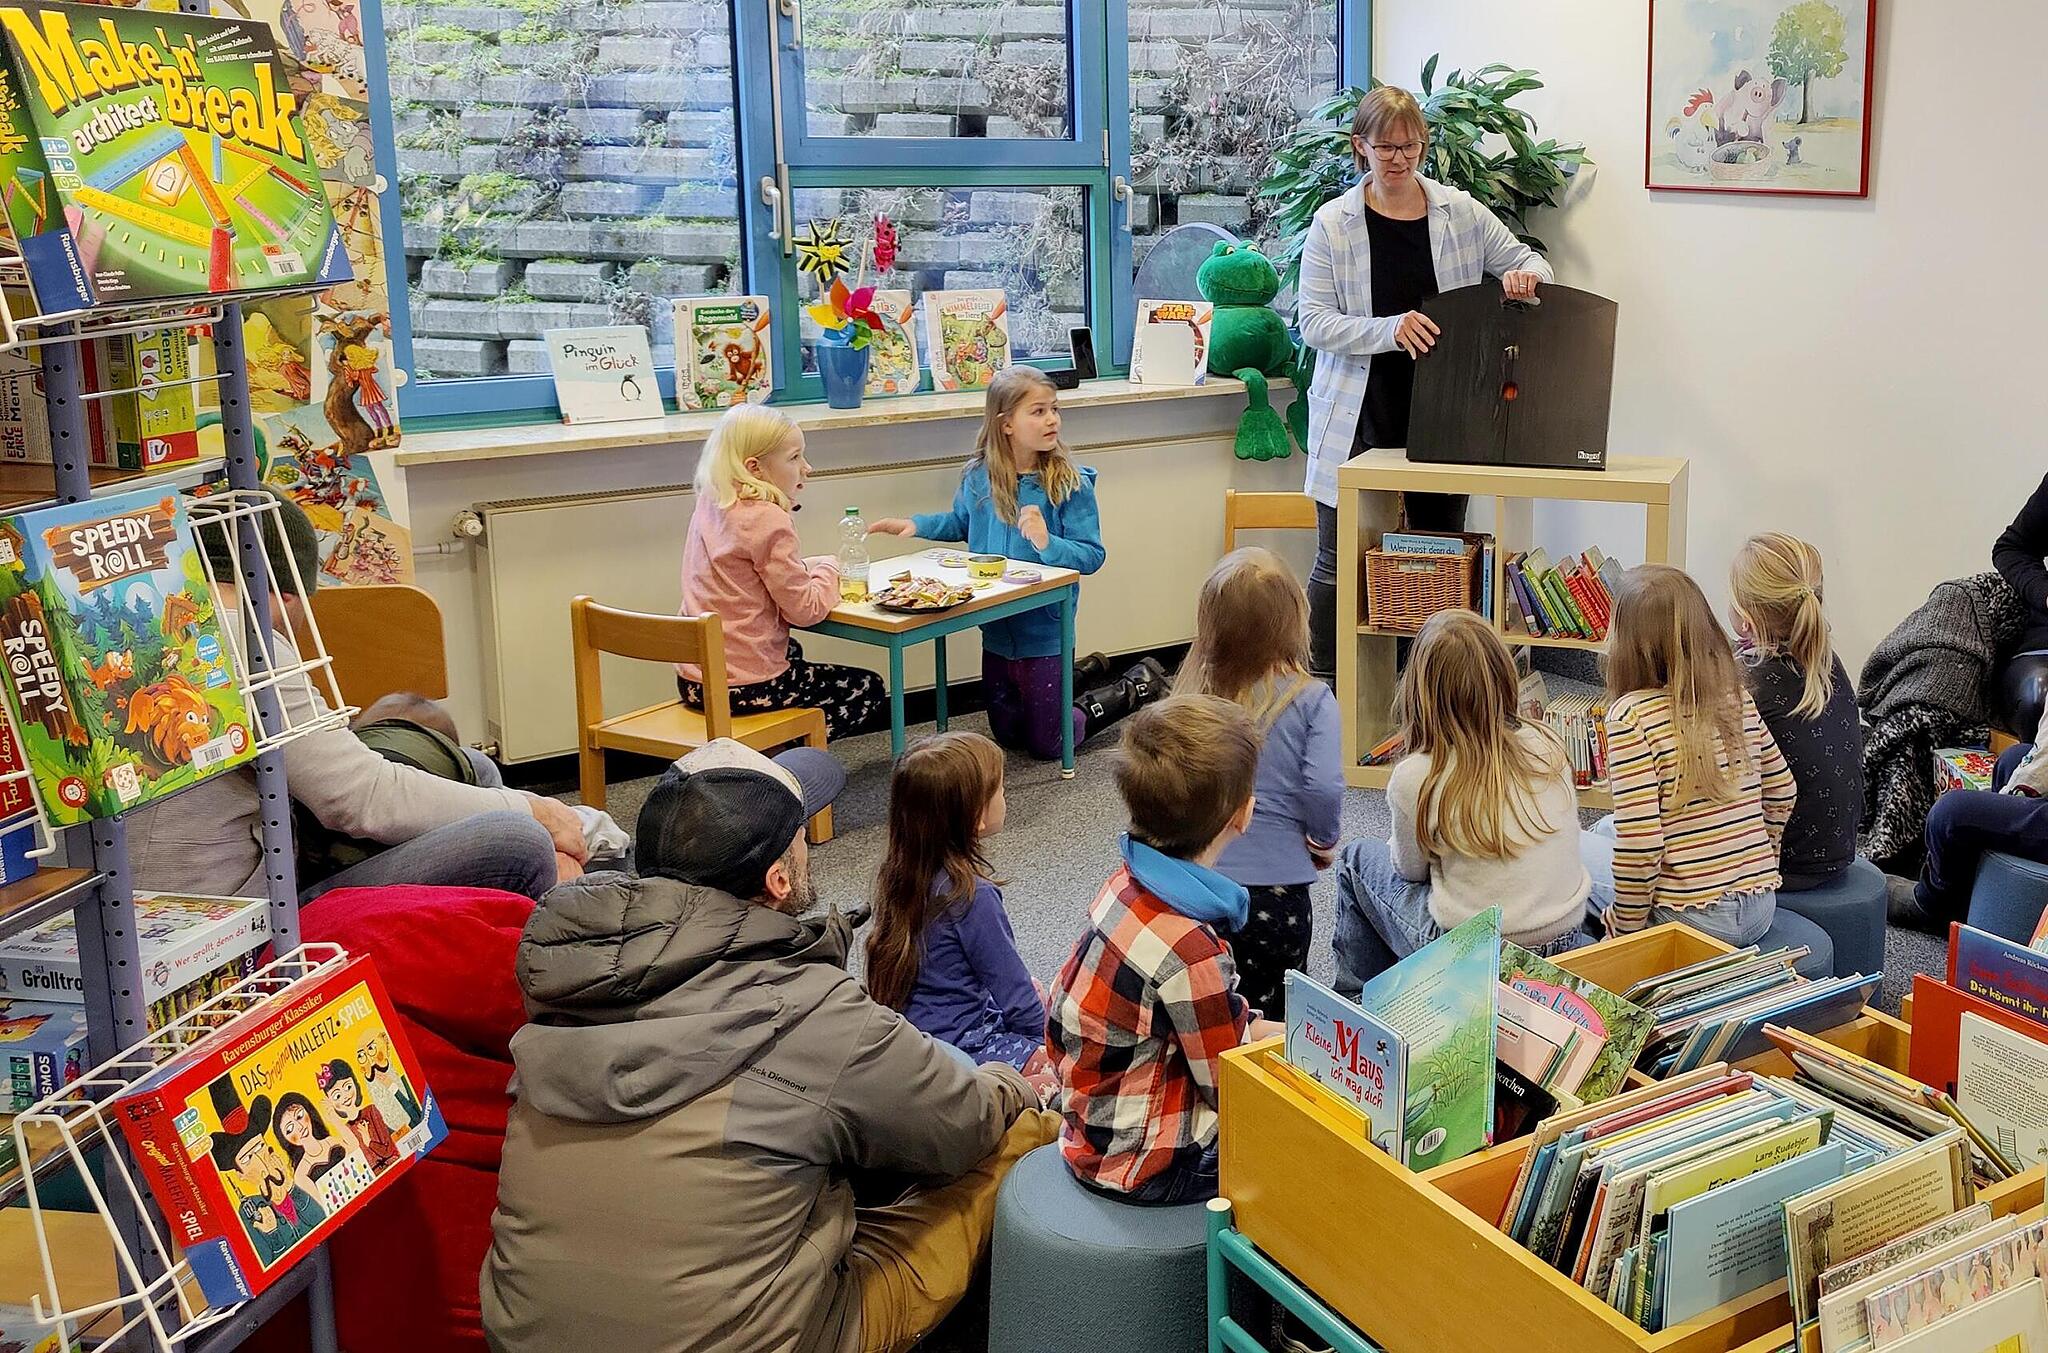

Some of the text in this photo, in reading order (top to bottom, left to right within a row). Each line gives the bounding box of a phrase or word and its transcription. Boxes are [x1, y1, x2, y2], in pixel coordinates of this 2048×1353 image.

[0, 8, 162, 116] Make
[72, 96, 161, 154] architect
[159, 62, 306, 163] Break
[60, 233, 90, 303] Ravensburger
[320, 229, 340, 279] Ravensburger
[1157, 304, 1195, 312] STAR
[1157, 310, 1195, 320] WARS
[562, 344, 616, 362] Pinguin
[585, 354, 639, 371] im Glück
[4, 426, 17, 458] ERIC
[14, 426, 26, 458] CARLE
[70, 514, 154, 557] SPEEDY
[1390, 543, 1407, 552] Wer
[88, 543, 152, 580] ROLL
[4, 637, 35, 705] ROLL
[20, 619, 69, 714] SPEEDY
[174, 956, 191, 968] Wer
[192, 943, 215, 963] grollt
[216, 934, 234, 947] denn
[1969, 979, 1987, 996] Die
[1989, 986, 2020, 1008] könnt
[2022, 999, 2039, 1014] ihr
[221, 992, 324, 1064] Ravensburger Klassiker
[1304, 1021, 1332, 1053] Kleine
[744, 1063, 807, 1093] lack Diamond
[1330, 1062, 1383, 1110] ich mag dich
[1755, 1152, 1773, 1163] Lars
[179, 1210, 204, 1241] SPIEL
[218, 1240, 249, 1298] Ravensburger
